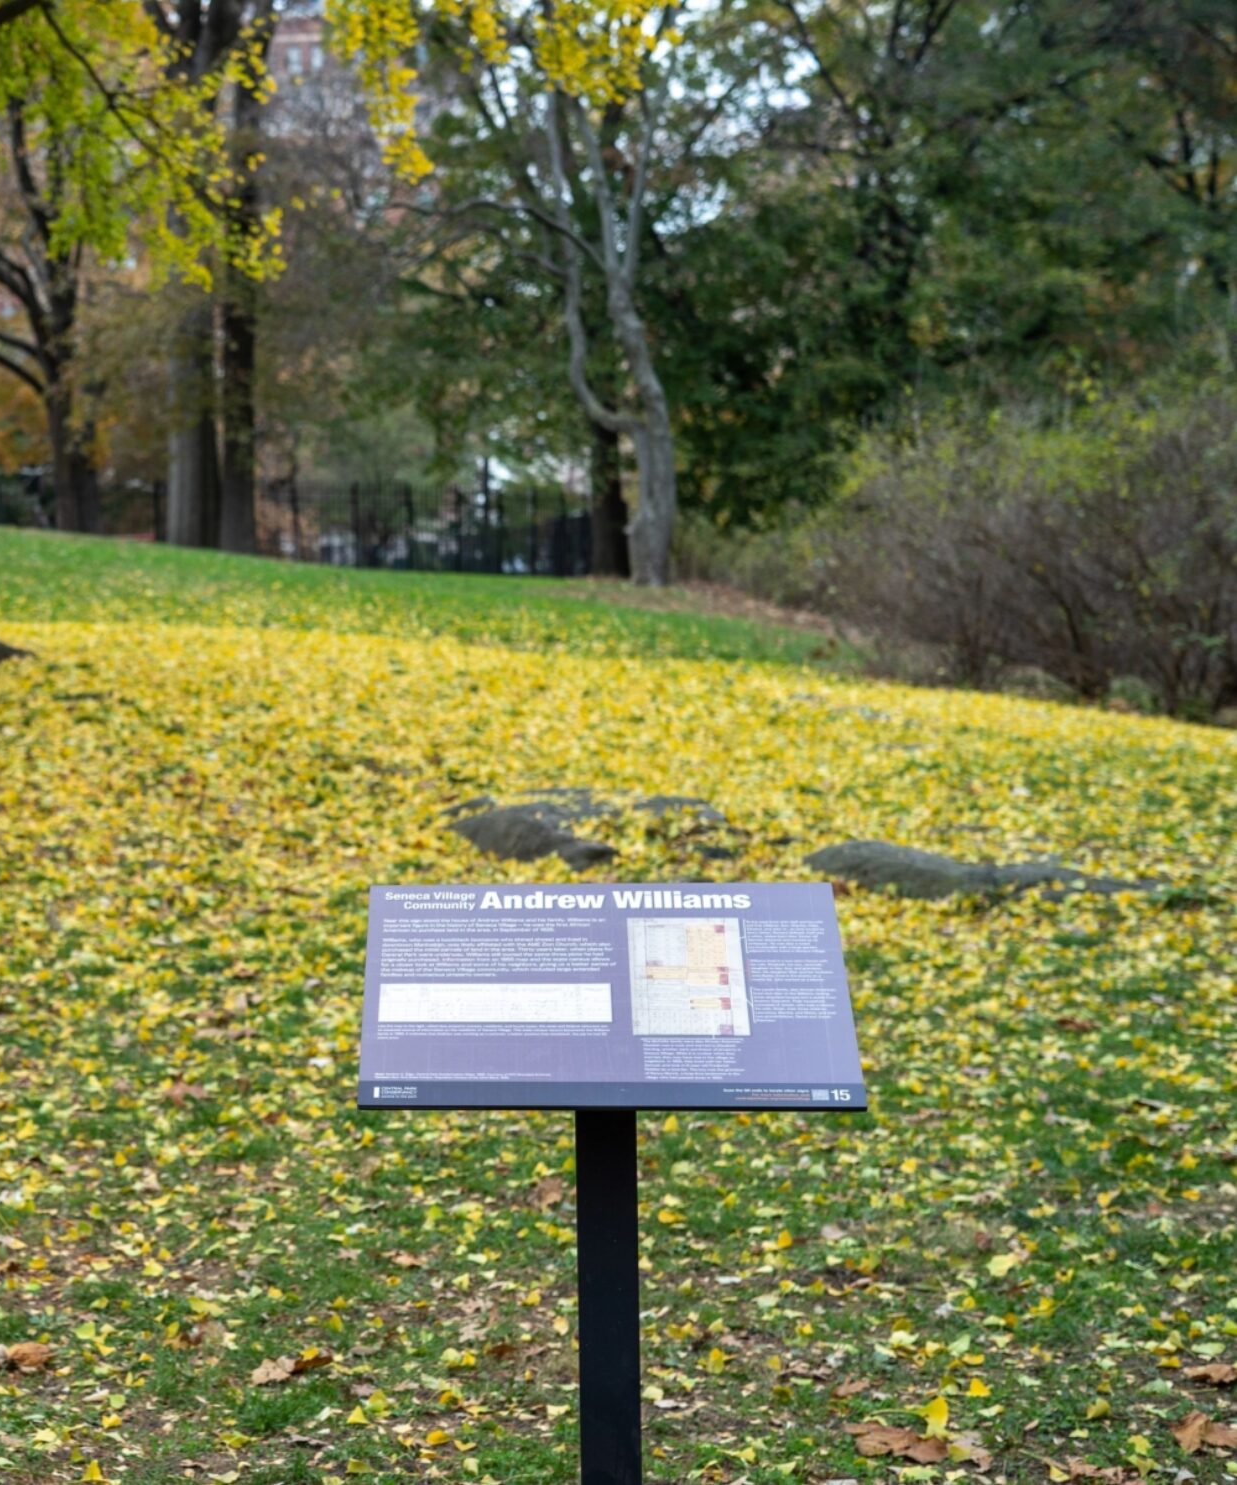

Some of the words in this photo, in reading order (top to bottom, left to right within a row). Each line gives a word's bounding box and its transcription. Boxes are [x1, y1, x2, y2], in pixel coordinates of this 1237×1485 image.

[385, 892, 430, 901] Seneca
[434, 892, 476, 902] Village
[480, 891, 605, 910] Andrew
[612, 890, 752, 909] Williams
[403, 901, 476, 911] Community
[830, 1089, 851, 1101] 15
